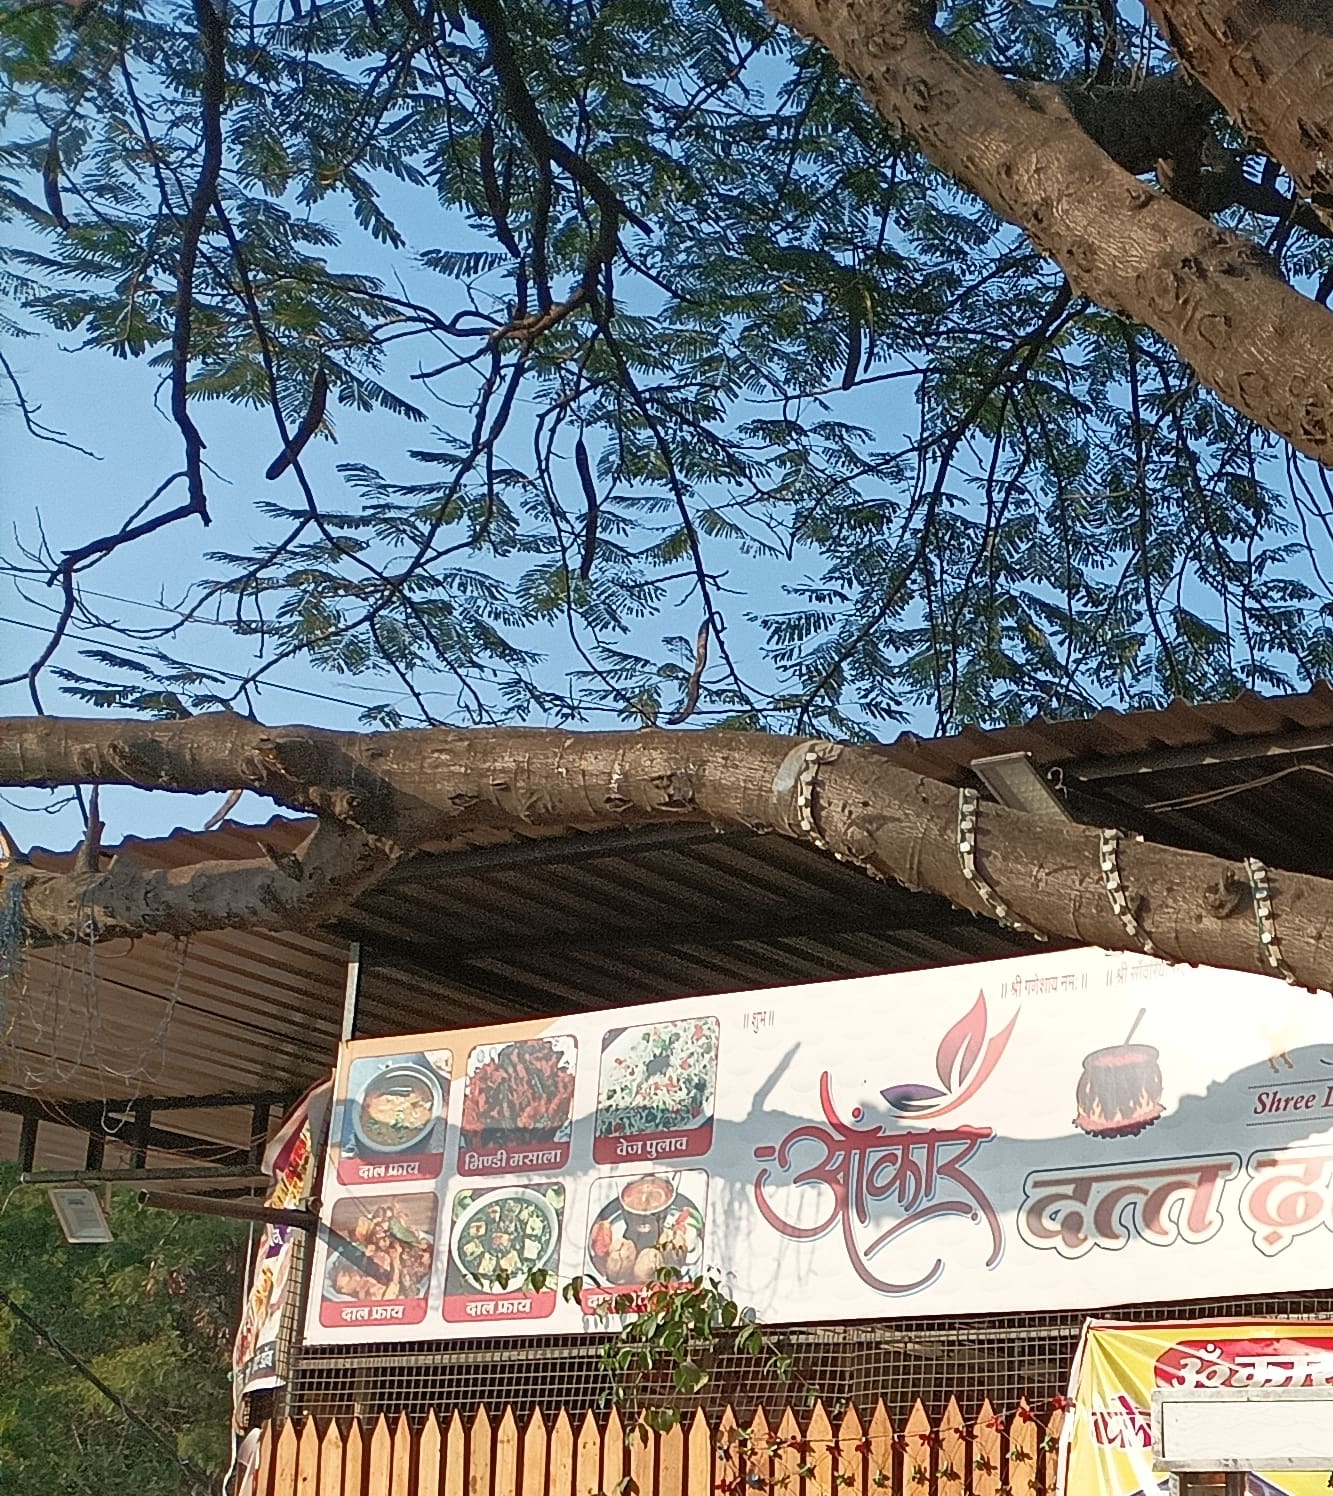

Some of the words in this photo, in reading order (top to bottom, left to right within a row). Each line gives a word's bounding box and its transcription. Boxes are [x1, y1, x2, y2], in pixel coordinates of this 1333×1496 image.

[1252, 1089, 1316, 1115] Shree
[616, 1138, 642, 1155] वेज
[645, 1135, 688, 1160] पुलाव
[510, 1149, 562, 1167] मसाला
[358, 1164, 385, 1179] दाल
[1022, 1157, 1236, 1249] दत्त
[341, 1306, 368, 1321] दाल
[465, 1300, 495, 1315] दाल
